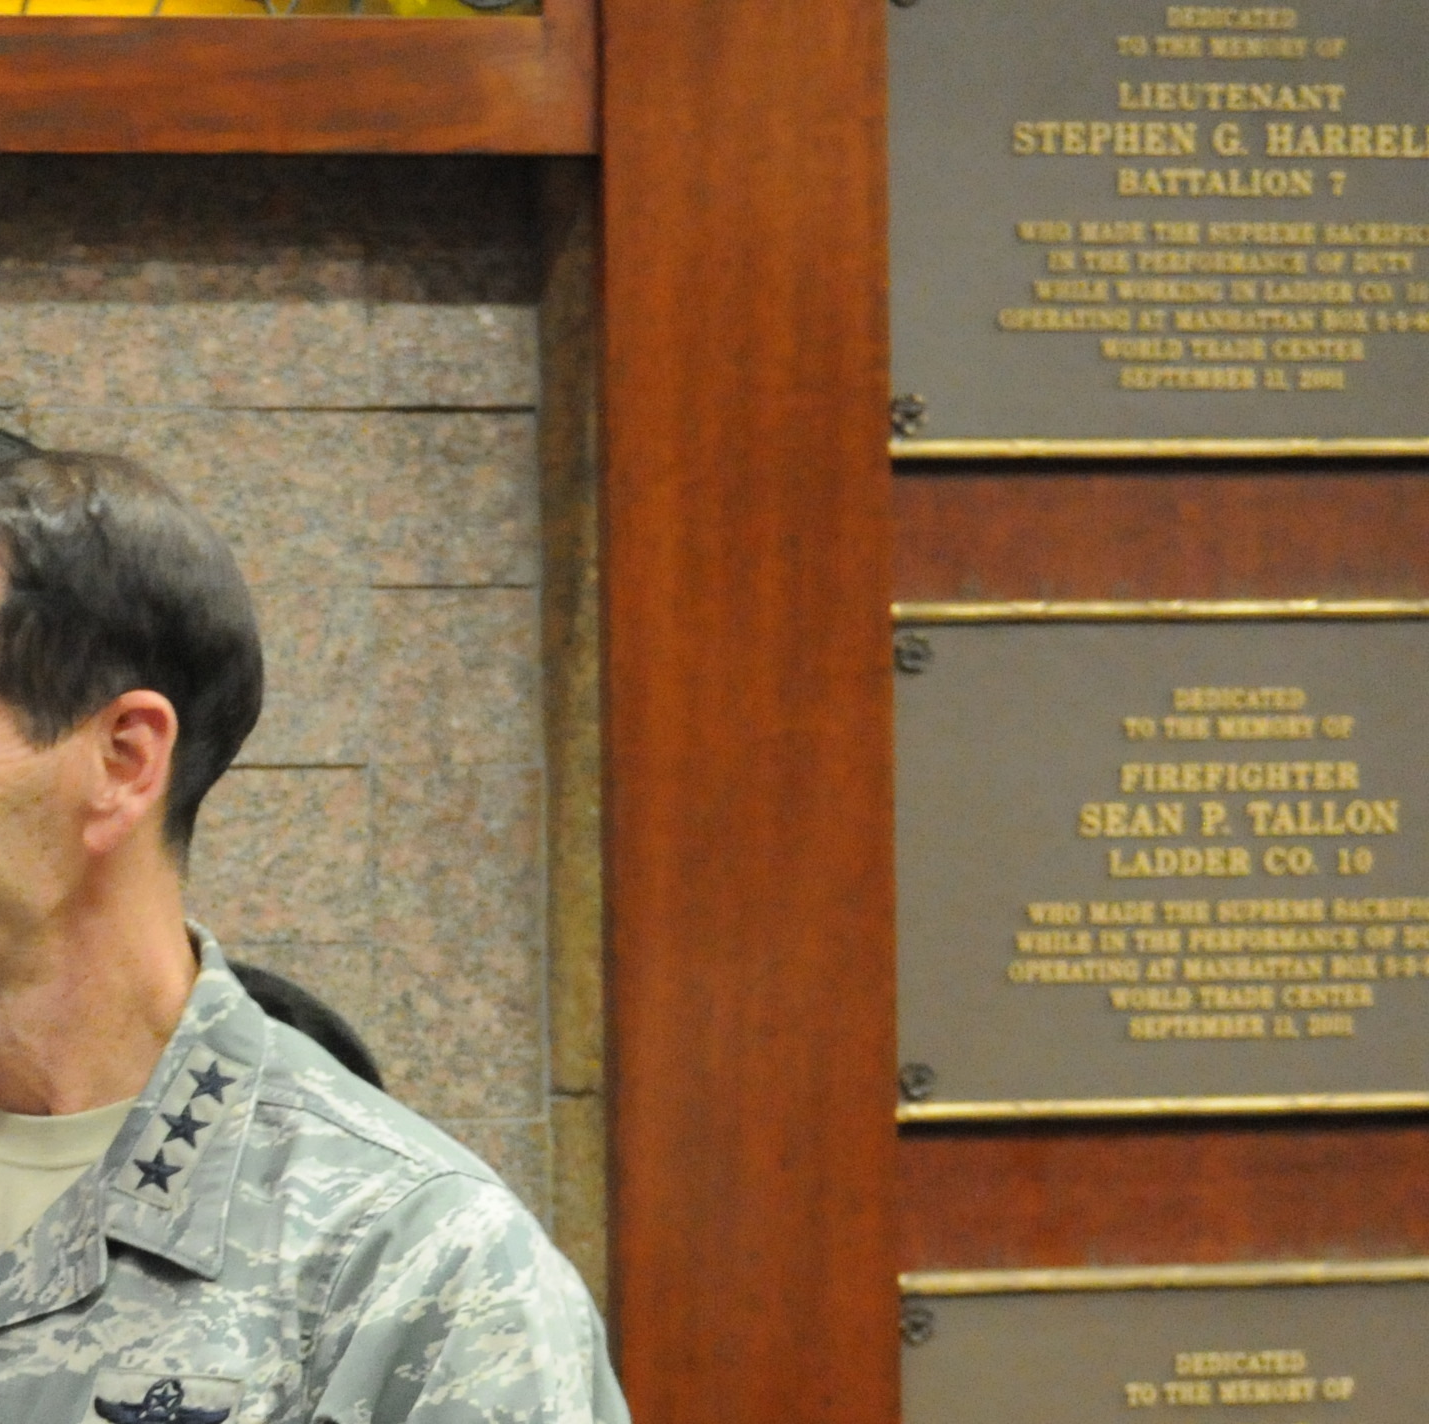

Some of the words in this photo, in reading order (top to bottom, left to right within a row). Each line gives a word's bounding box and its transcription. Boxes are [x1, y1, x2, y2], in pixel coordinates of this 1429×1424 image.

[1118, 81, 1346, 112] LIEUTENANT
[1013, 120, 1197, 156] STEPHEN
[1267, 123, 1429, 158] HARREL
[1117, 167, 1314, 196] BATTALION
[1121, 760, 1360, 792] FIREFIGHTER
[1079, 801, 1184, 837] SEAN
[1248, 799, 1401, 835] TALLON
[1109, 846, 1250, 877] LADDER
[1264, 845, 1318, 875] CO.
[1339, 846, 1375, 874] 10
